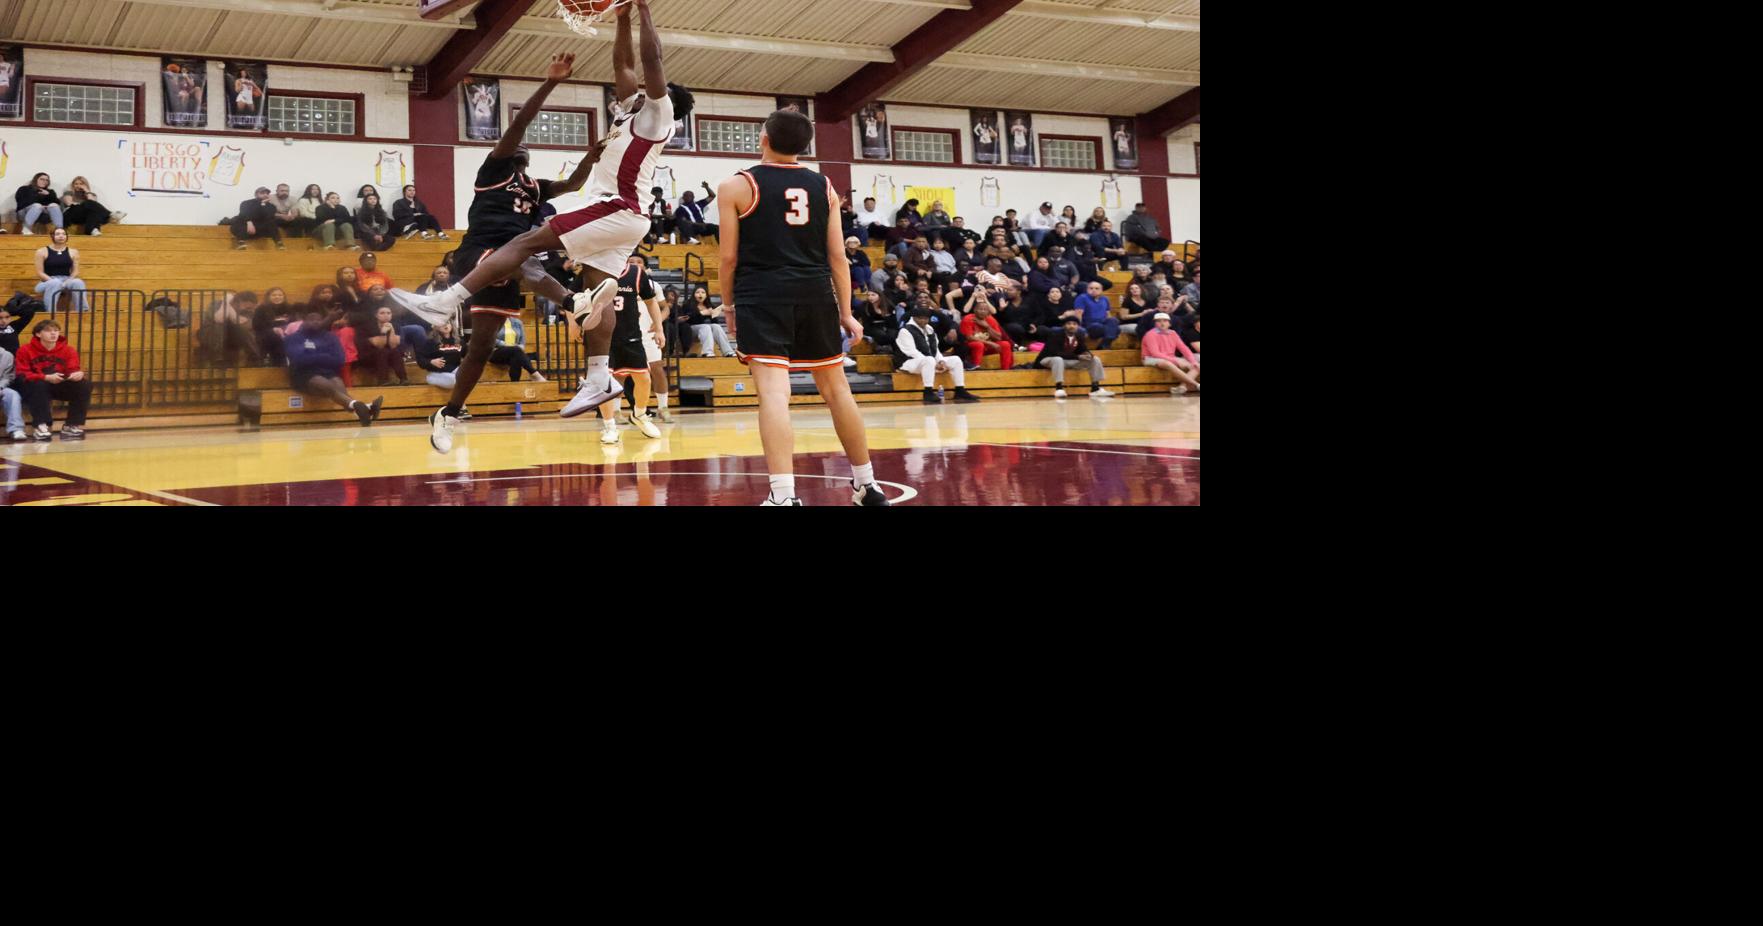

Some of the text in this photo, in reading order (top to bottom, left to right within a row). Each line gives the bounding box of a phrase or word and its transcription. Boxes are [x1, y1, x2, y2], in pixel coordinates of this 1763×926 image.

[175, 144, 201, 157] GO
[132, 155, 202, 170] LIBERTY
[131, 170, 206, 190] LIONS
[784, 187, 810, 226] 3
[613, 295, 625, 311] 3
